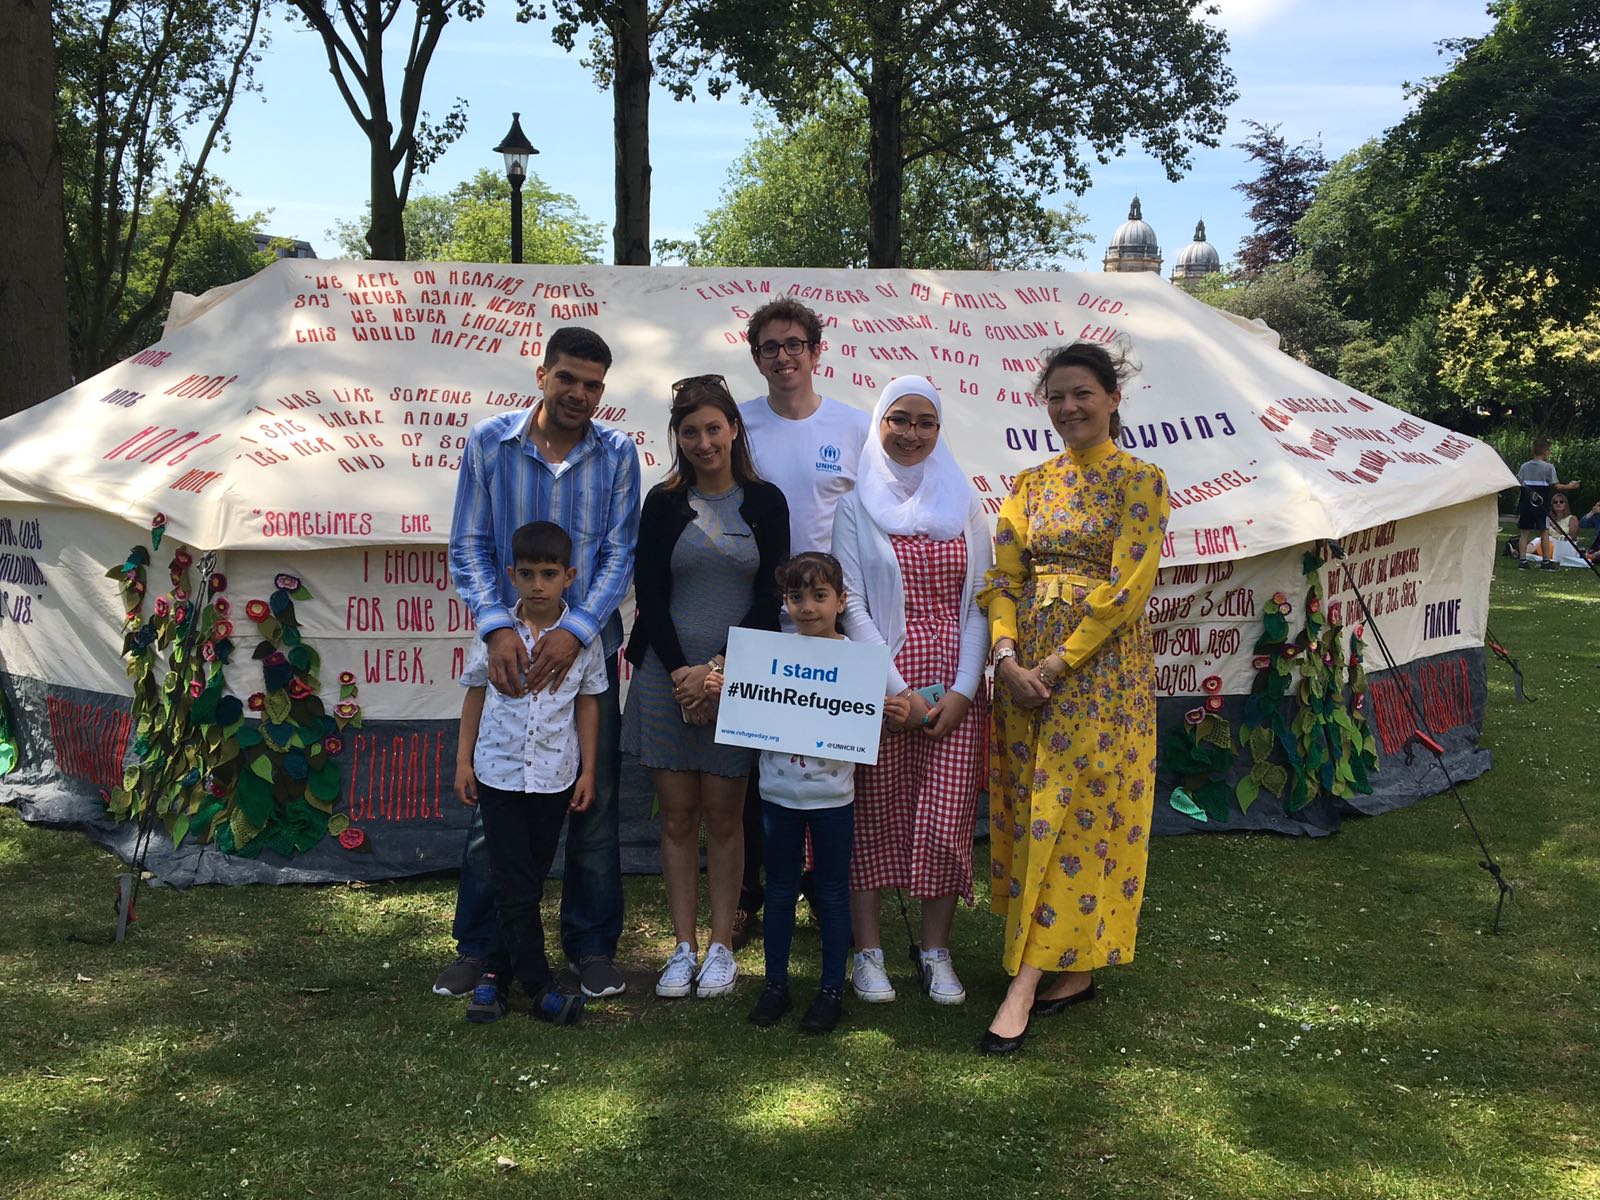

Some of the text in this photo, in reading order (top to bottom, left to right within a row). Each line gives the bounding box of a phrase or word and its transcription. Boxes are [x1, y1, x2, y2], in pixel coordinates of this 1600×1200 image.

[357, 272, 399, 288] KEPT
[414, 270, 436, 285] ON
[450, 270, 524, 295] HEARING
[532, 282, 595, 299] PEOPLE
[786, 283, 871, 304] MEMBERS
[875, 282, 899, 299] OF
[910, 281, 931, 301] MY
[941, 291, 1007, 310] FAMILY
[1014, 286, 1062, 305] HAVE
[294, 293, 330, 309] SAY
[486, 295, 536, 318] NEVER
[351, 307, 543, 337] WE NEVER THOUGHT
[949, 319, 972, 336] WE
[984, 320, 1065, 341] COULDN'T
[1080, 323, 1119, 343] TELL
[296, 326, 542, 357] THIS WOULD HAPPEN TO
[131, 349, 173, 367] HOME
[841, 344, 858, 358] OF
[868, 345, 919, 361] THEM
[930, 345, 980, 368] FROM
[162, 374, 239, 399] HOME
[852, 372, 877, 389] WE
[960, 379, 979, 395] TO
[100, 388, 147, 408] HOME
[276, 389, 323, 411] WAS
[332, 387, 375, 403] LIKE
[389, 386, 472, 405] SOMEONE
[259, 418, 307, 438] SAT
[318, 410, 385, 429] THERE
[403, 411, 469, 428] AMONG
[102, 425, 222, 466] HOME
[289, 436, 336, 457] HER
[343, 432, 384, 449] DIE
[337, 453, 385, 473] AND
[815, 462, 842, 472] UNHCR
[168, 468, 223, 493] HOME
[973, 475, 993, 493] OF
[19, 518, 43, 549] LOST
[401, 513, 432, 534] THE
[363, 551, 370, 583] I
[346, 596, 385, 632] FOR
[396, 598, 436, 633] ONE
[1200, 590, 1214, 617] 3
[1217, 587, 1256, 618] YEAR
[1423, 598, 1462, 641] FAMINE
[1206, 628, 1241, 659] AGED
[364, 647, 435, 686] WEEK,
[771, 659, 839, 683] I stand
[727, 681, 876, 716] #WithRefugees
[720, 728, 780, 742] www.refugeeday.org
[826, 742, 855, 752] @UNHCR
[350, 729, 445, 822] CLIMATE
